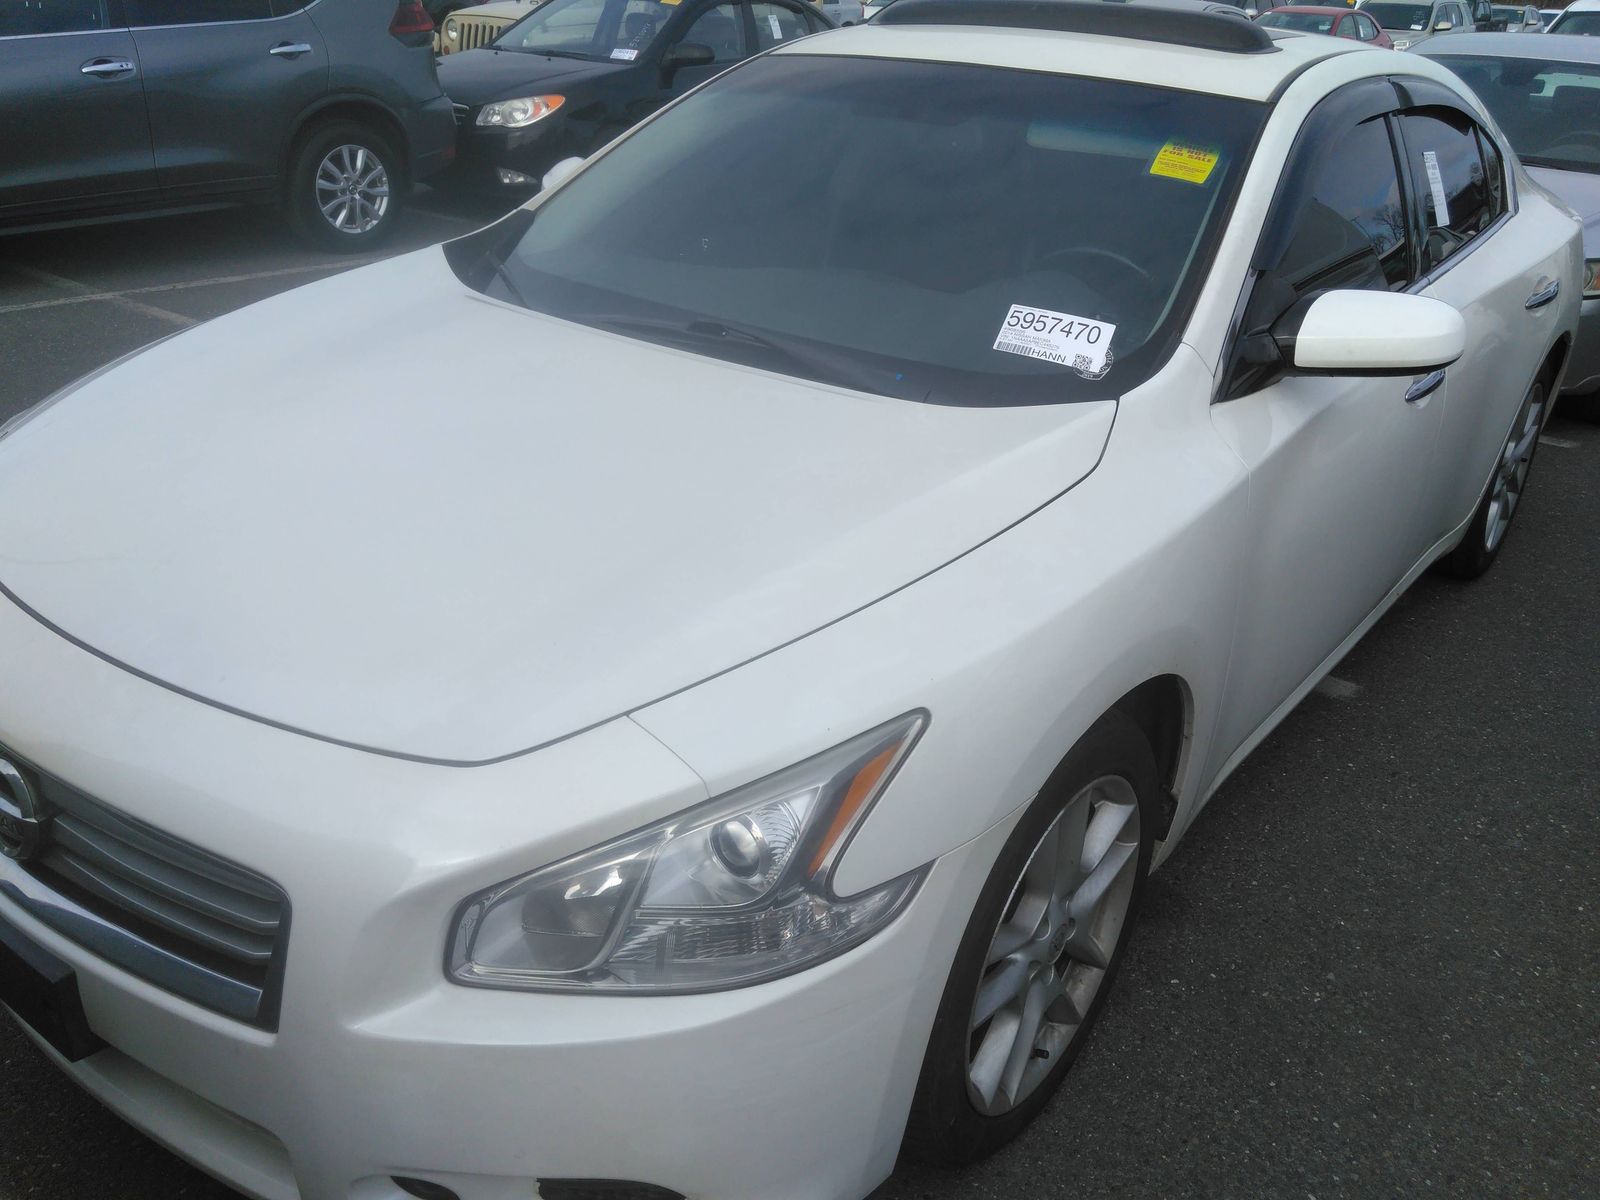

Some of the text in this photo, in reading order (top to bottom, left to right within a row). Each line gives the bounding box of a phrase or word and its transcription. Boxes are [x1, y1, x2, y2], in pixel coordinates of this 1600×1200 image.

[1187, 154, 1212, 163] SALE
[1007, 310, 1101, 344] 5957470
[1031, 348, 1066, 363] HANN
